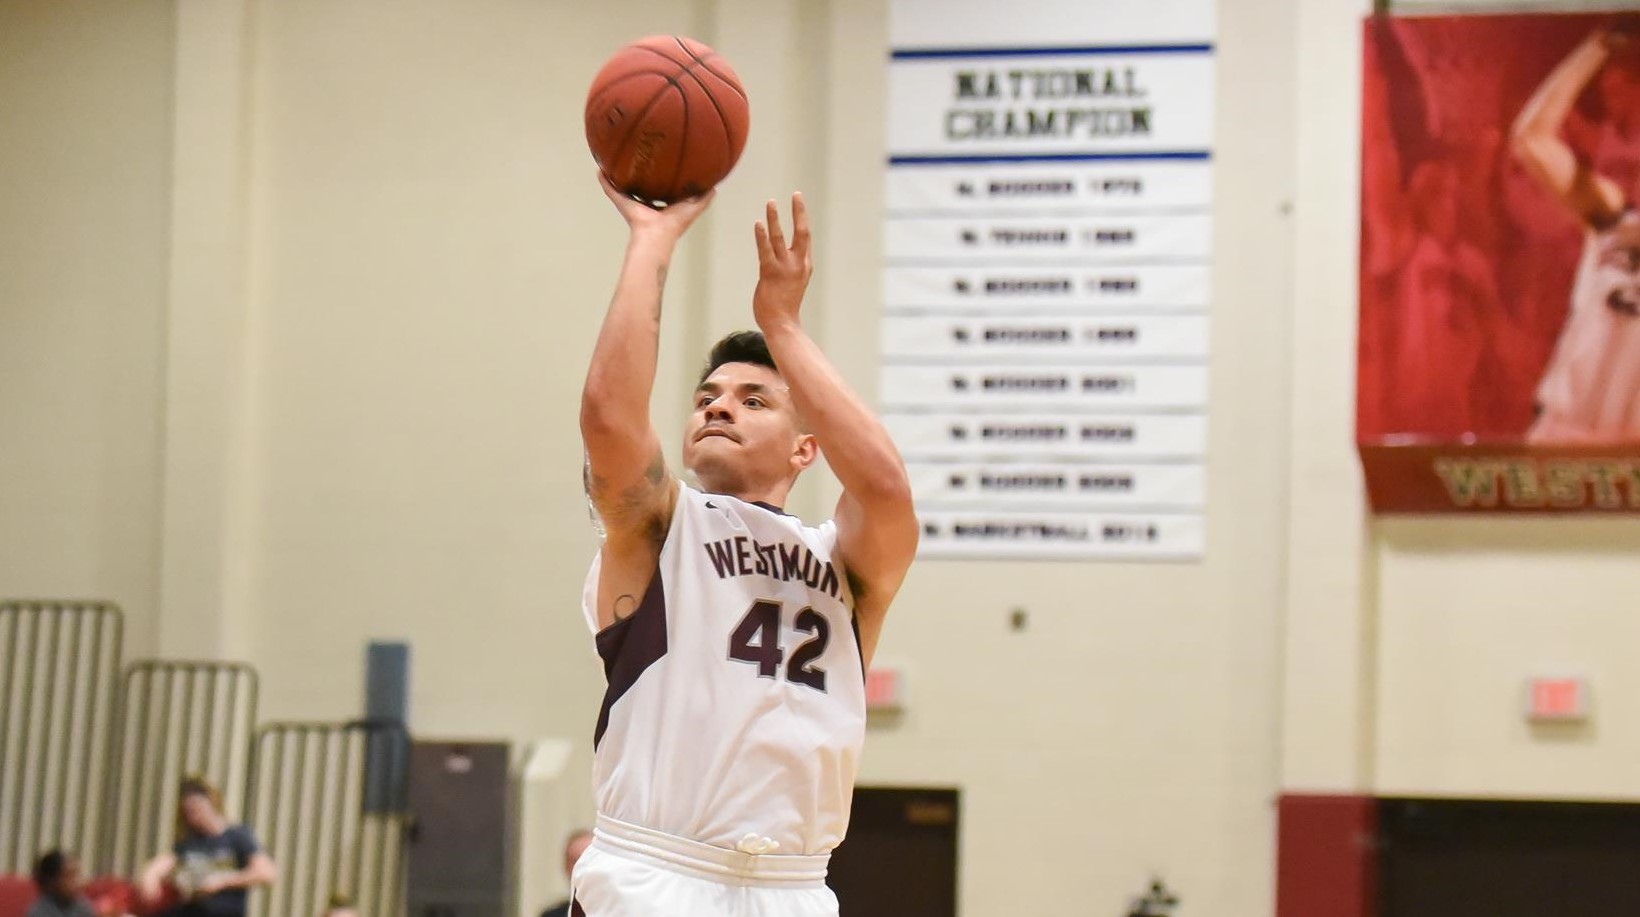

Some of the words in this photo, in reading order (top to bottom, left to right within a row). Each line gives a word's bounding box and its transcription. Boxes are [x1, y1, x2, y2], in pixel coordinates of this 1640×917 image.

[954, 68, 1147, 99] NATIONAL
[945, 106, 1152, 139] CHAMPION
[1432, 457, 1640, 507] WEST
[704, 536, 844, 602] WESTMON
[726, 598, 831, 694] 42
